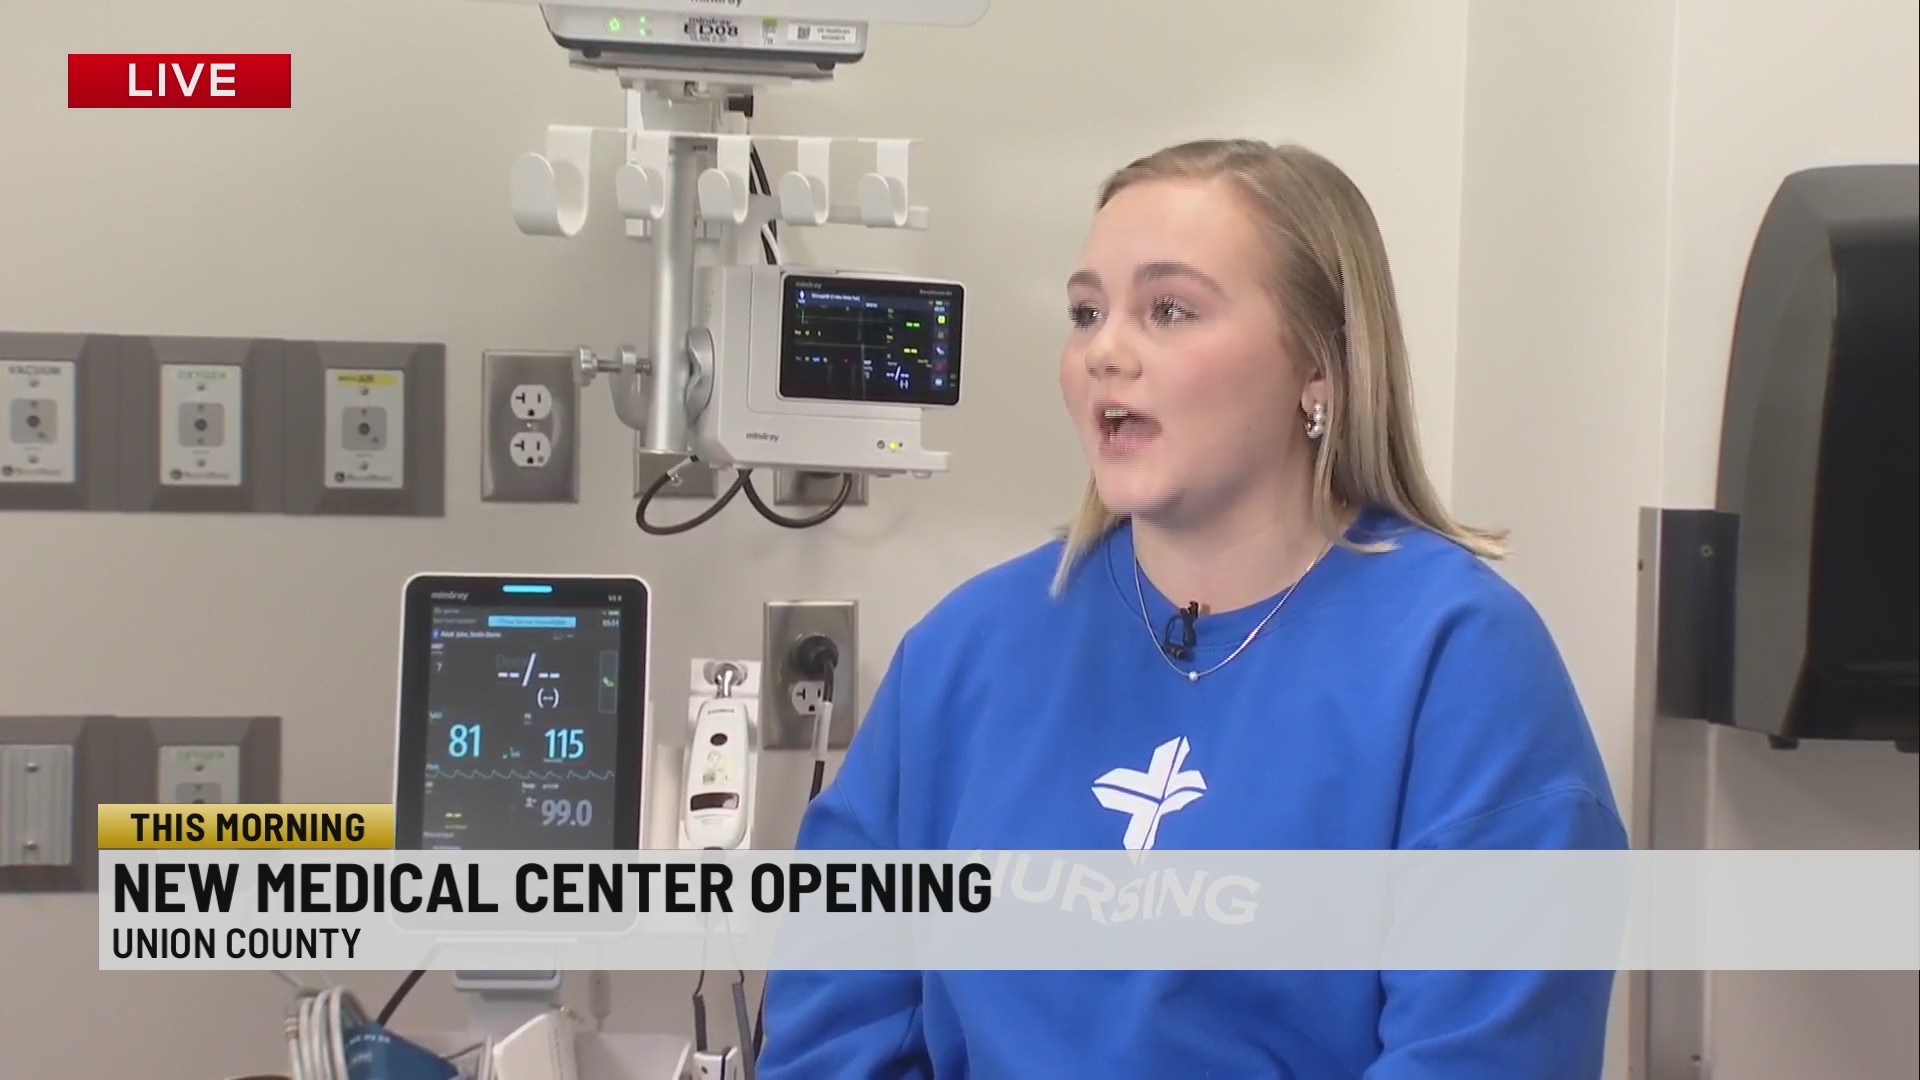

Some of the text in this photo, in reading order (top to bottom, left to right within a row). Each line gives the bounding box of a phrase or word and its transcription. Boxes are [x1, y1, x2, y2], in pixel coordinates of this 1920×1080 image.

[746, 432, 779, 442] mindray
[431, 591, 469, 602] mindray
[448, 724, 481, 758] 81
[544, 729, 584, 759] 115
[541, 799, 592, 826] 99.0
